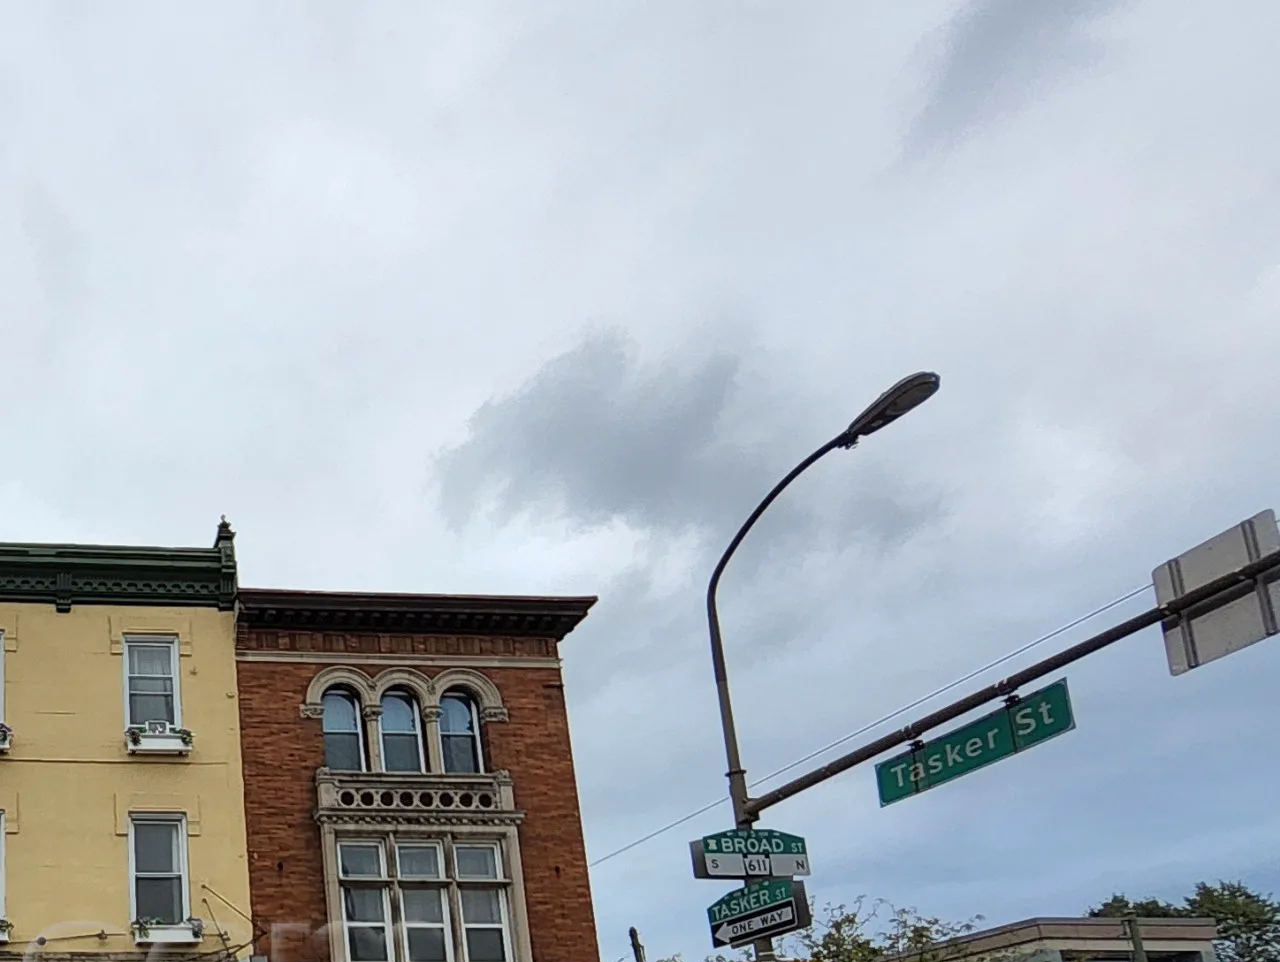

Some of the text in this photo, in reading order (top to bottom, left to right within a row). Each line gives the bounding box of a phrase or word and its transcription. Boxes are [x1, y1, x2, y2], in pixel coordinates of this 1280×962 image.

[890, 701, 1055, 788] Tasker St
[721, 838, 803, 853] BROAD ST
[711, 859, 720, 869] S
[748, 860, 767, 871] 611
[796, 860, 805, 870] N
[712, 889, 770, 921] TASKER
[775, 887, 787, 900] ST
[732, 910, 784, 935] ONE WAY
